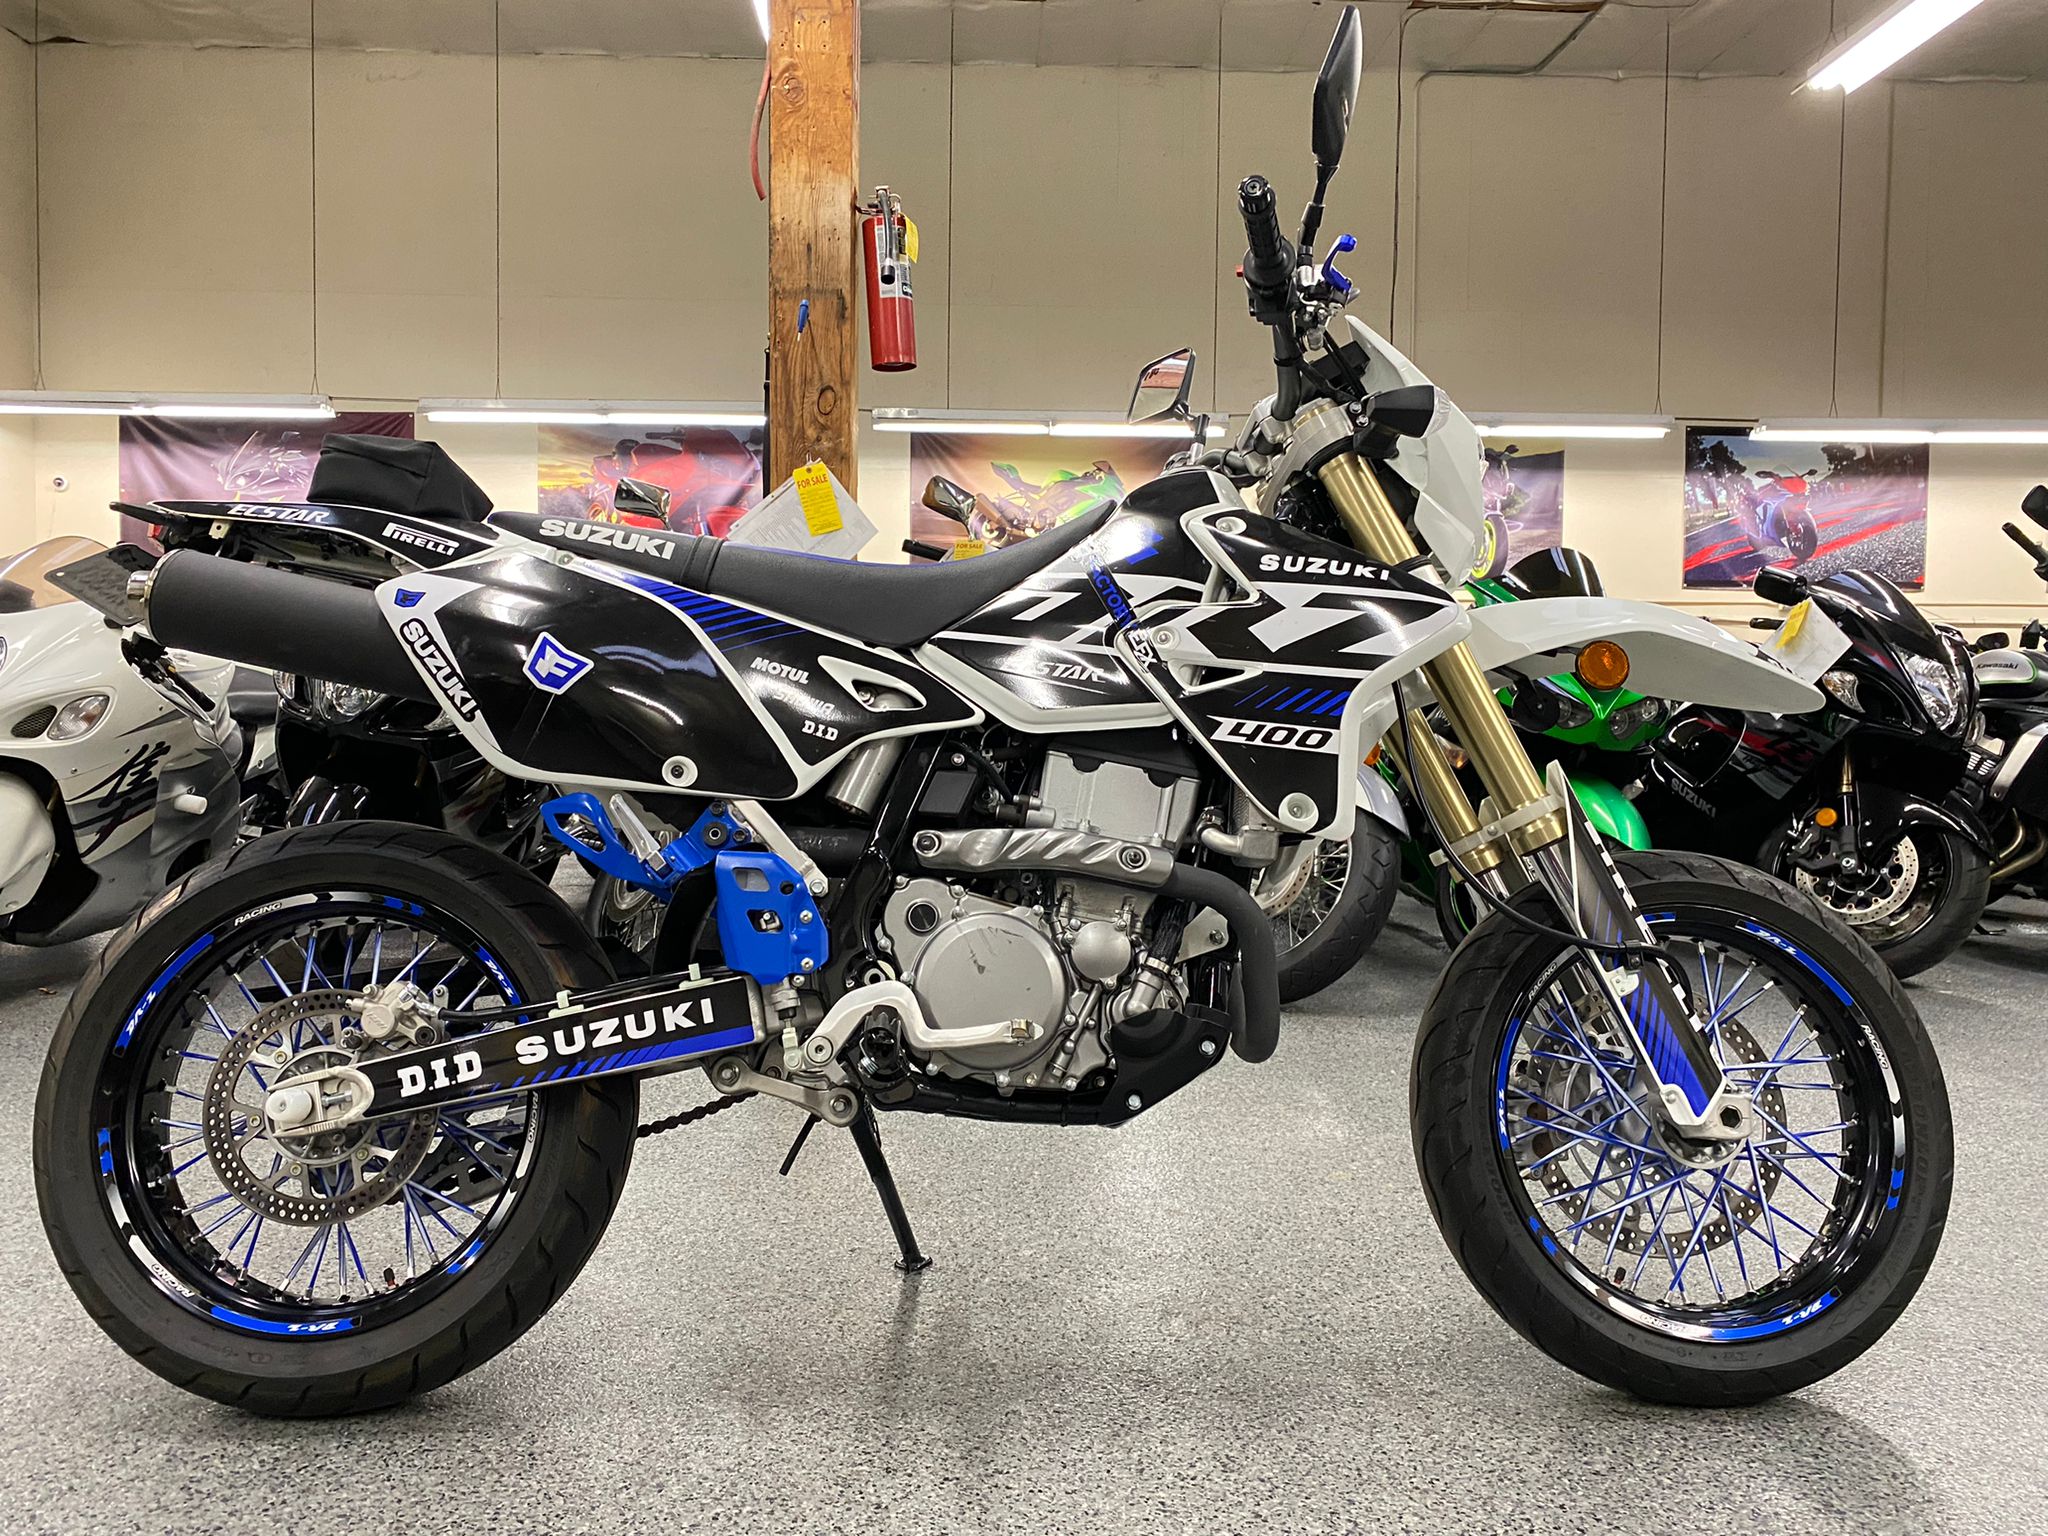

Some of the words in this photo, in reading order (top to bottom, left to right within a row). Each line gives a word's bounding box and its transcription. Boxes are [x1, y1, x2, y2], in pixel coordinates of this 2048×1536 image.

[797, 479, 812, 489] FOR
[812, 474, 828, 486] SALE
[228, 504, 330, 525] ECSTAR
[382, 522, 460, 556] PIRELLI
[539, 519, 676, 560] SUZUKI
[1259, 554, 1390, 581] SUZUKI
[402, 621, 477, 714] SUZUKI
[750, 656, 809, 684] MOTUL
[1012, 658, 1106, 684] STAR
[1975, 662, 2019, 670] Kawasaki
[801, 720, 838, 741] D.I.D
[1227, 721, 1333, 749] 400
[1671, 777, 1717, 818] SUZUKI
[234, 902, 282, 927] RACING
[1528, 962, 1557, 1001] RACING
[397, 1051, 482, 1098] D.I.D
[515, 998, 715, 1065] SUZUKI
[1860, 1024, 1889, 1069] RACING
[527, 1091, 539, 1142] RACING
[152, 1264, 195, 1298] RACING
